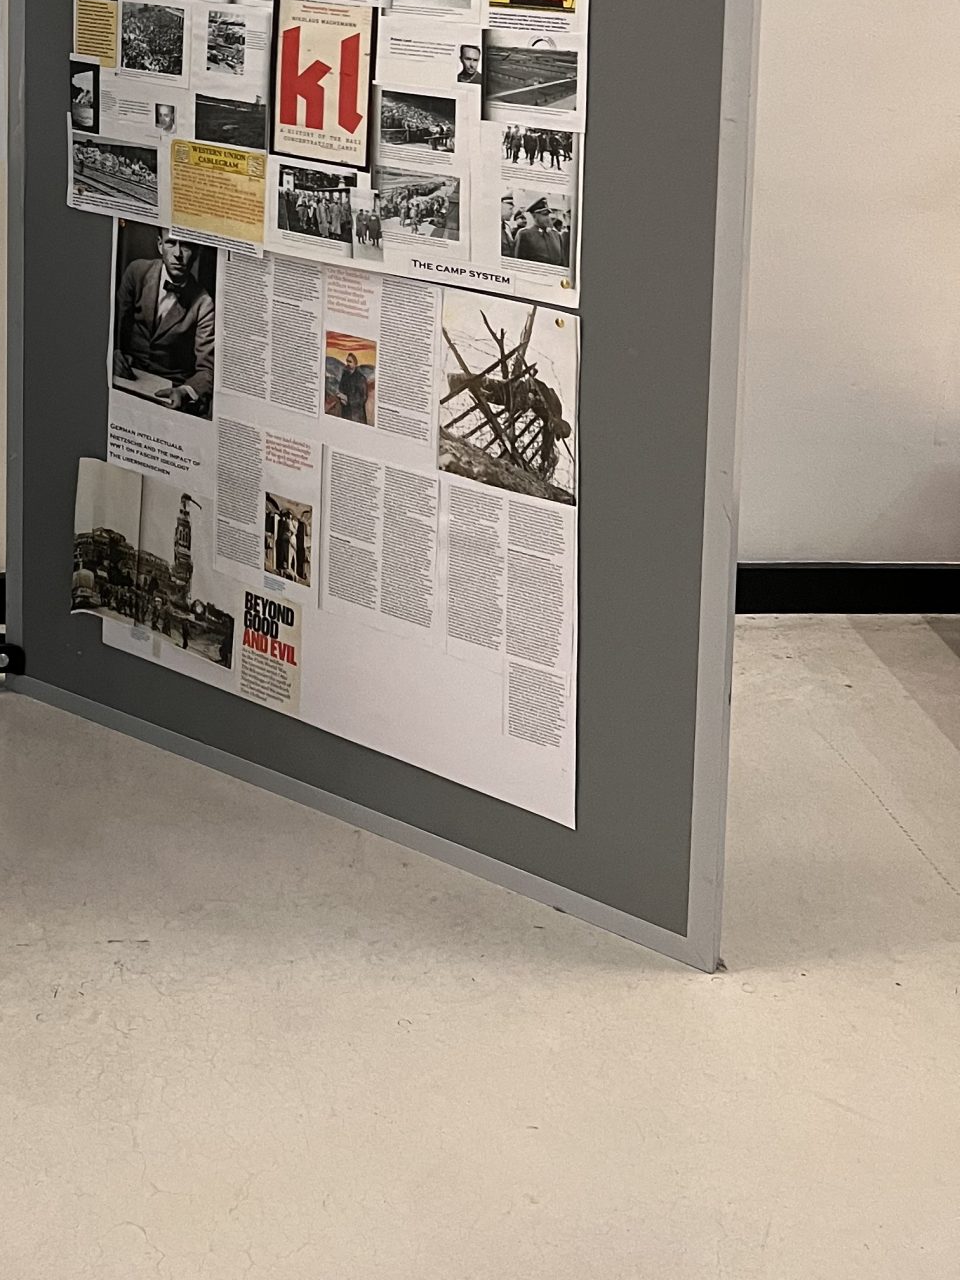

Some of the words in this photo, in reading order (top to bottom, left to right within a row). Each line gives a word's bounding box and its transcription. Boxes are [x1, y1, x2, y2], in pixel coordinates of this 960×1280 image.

[411, 258, 434, 271] THE
[435, 264, 467, 276] CAMP
[468, 270, 510, 285] SYSTEM
[243, 610, 279, 640] GOOD
[244, 590, 295, 627] BEYOND
[242, 627, 269, 654] AND
[270, 638, 297, 667] EVIL
